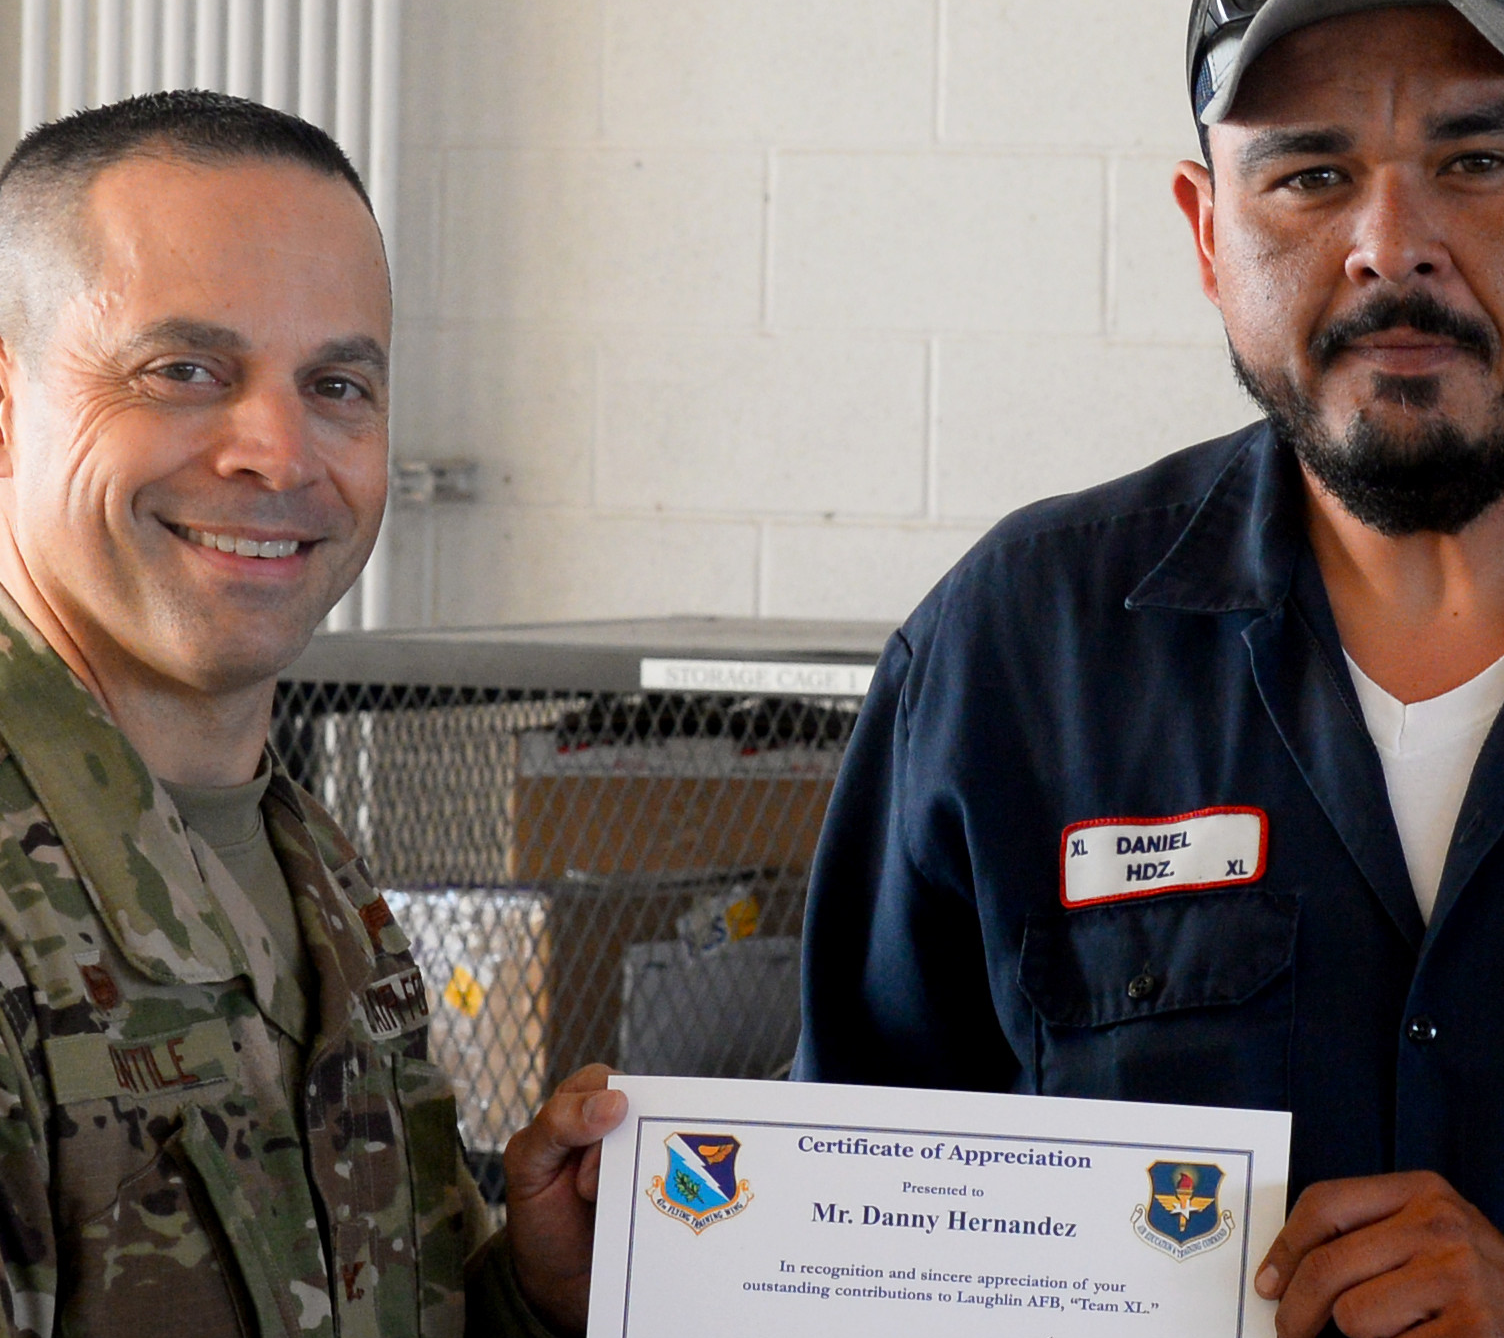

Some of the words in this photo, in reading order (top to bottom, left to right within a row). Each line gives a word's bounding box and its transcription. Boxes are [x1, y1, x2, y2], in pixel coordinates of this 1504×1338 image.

[665, 666, 766, 686] STORAGE
[776, 669, 834, 688] CAGE
[1070, 839, 1088, 856] XL
[1116, 831, 1191, 855] DANIEL
[1126, 860, 1175, 881] HDZ.
[1225, 859, 1248, 877] XL
[798, 1135, 914, 1158] Certificate
[920, 1143, 945, 1159] of
[948, 1145, 1092, 1168] Appreciation
[902, 1181, 967, 1197] Presented
[971, 1186, 984, 1197] to
[811, 1202, 853, 1224] Mr.
[862, 1205, 939, 1234] Danny
[947, 1210, 1077, 1237] Hernandez
[780, 1260, 795, 1273] In
[800, 1264, 884, 1279] recognition
[889, 1268, 916, 1280] and
[920, 1270, 972, 1283] sincere
[977, 1274, 1068, 1290] appreciation
[1072, 1278, 1089, 1291] of
[1093, 1282, 1127, 1295] your
[742, 1281, 830, 1299] outstanding
[835, 1286, 932, 1302] contributions
[938, 1290, 952, 1303] to
[957, 1291, 1023, 1309] Laughlin
[1027, 1295, 1065, 1311] AFB,
[1070, 1297, 1119, 1312] “Team
